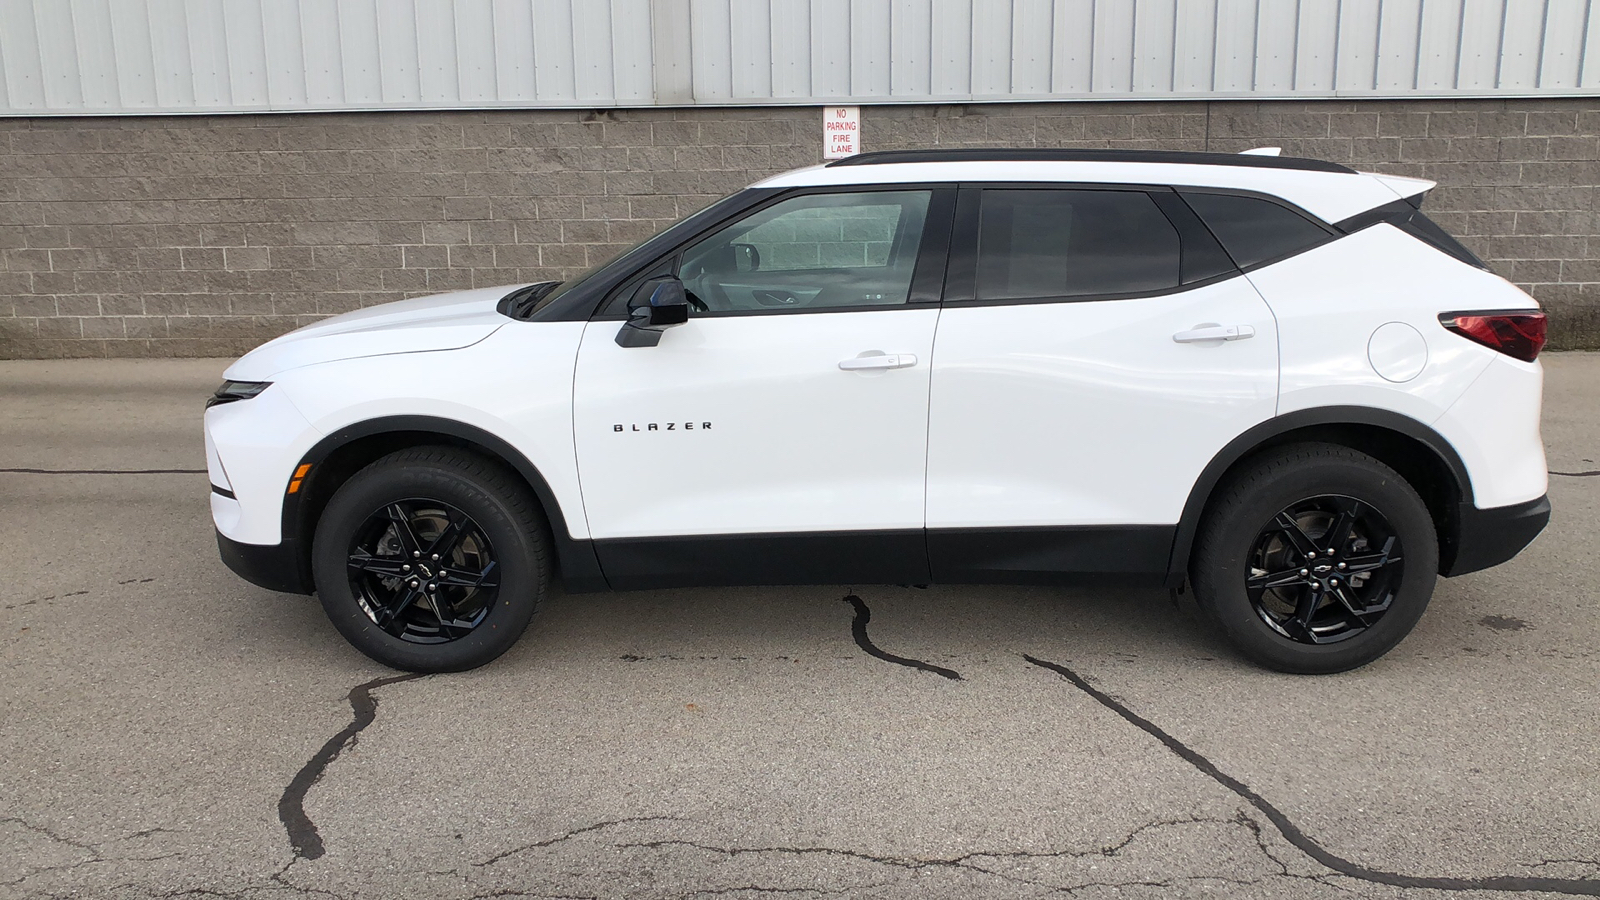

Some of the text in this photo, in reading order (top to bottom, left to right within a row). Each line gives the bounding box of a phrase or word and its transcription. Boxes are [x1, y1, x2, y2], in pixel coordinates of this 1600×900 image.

[836, 109, 847, 118] NO
[827, 121, 856, 131] PARKING
[833, 134, 850, 143] FIRE
[831, 145, 852, 153] LANE
[613, 421, 713, 432] BLAZER
